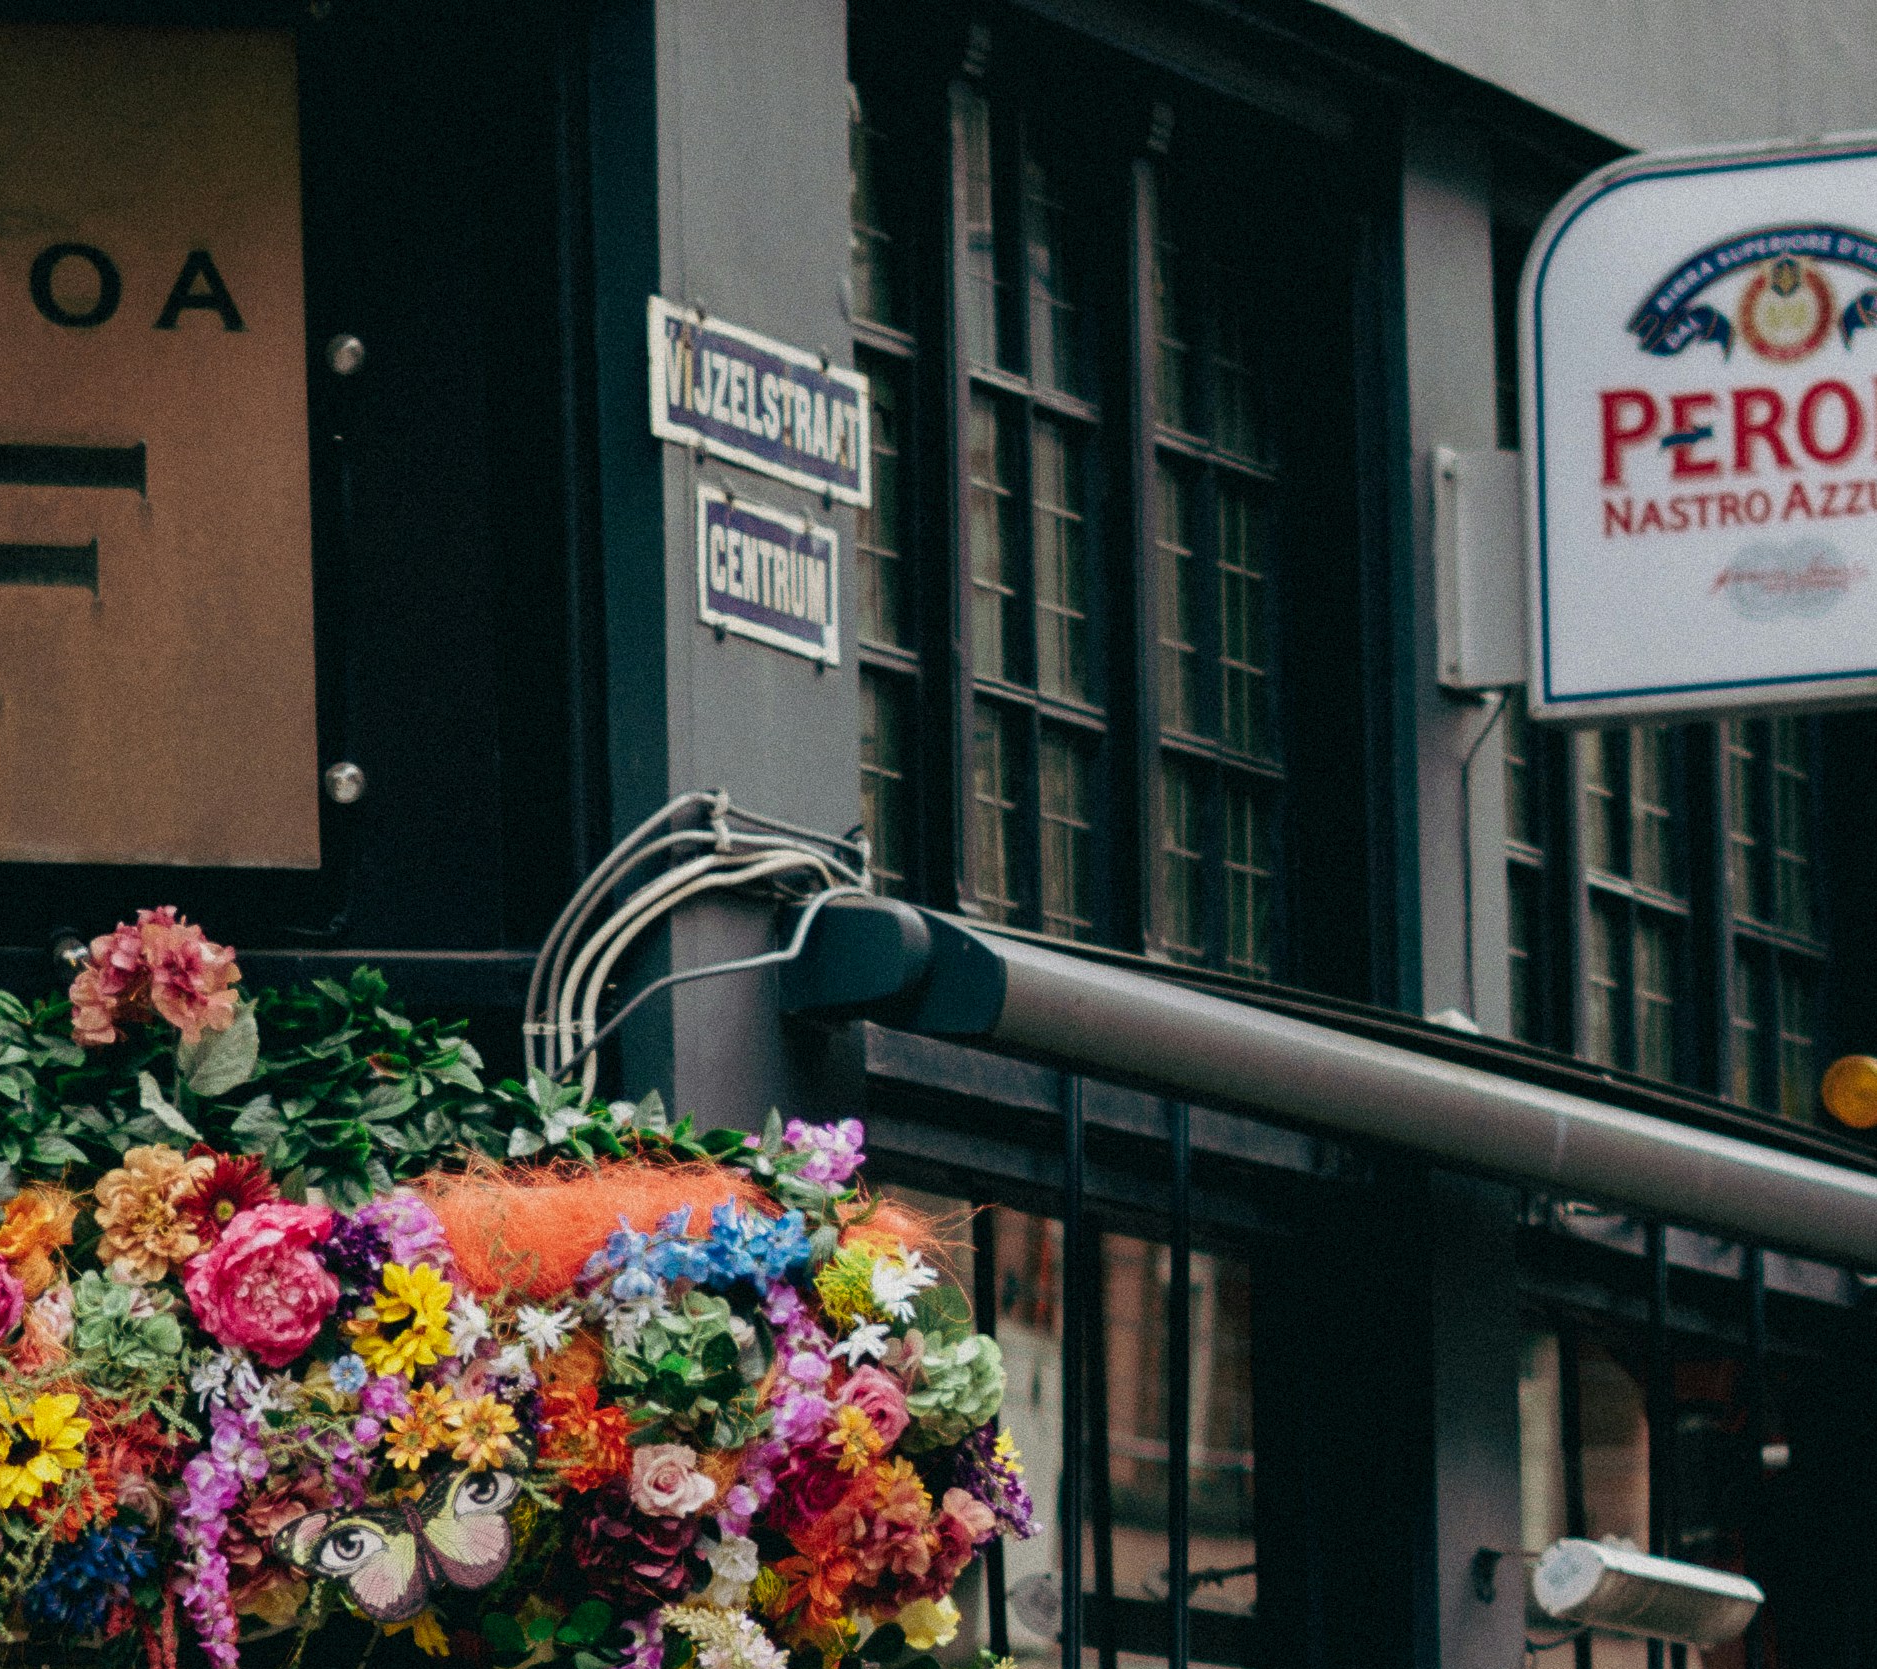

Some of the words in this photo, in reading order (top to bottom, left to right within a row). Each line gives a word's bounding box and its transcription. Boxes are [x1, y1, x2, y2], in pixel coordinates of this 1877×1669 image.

[666, 334, 859, 471] VIJZELSTRAAT
[1599, 376, 1877, 490] PERO
[1603, 490, 1772, 538] NASTRO
[708, 523, 826, 624] CENTRUM
